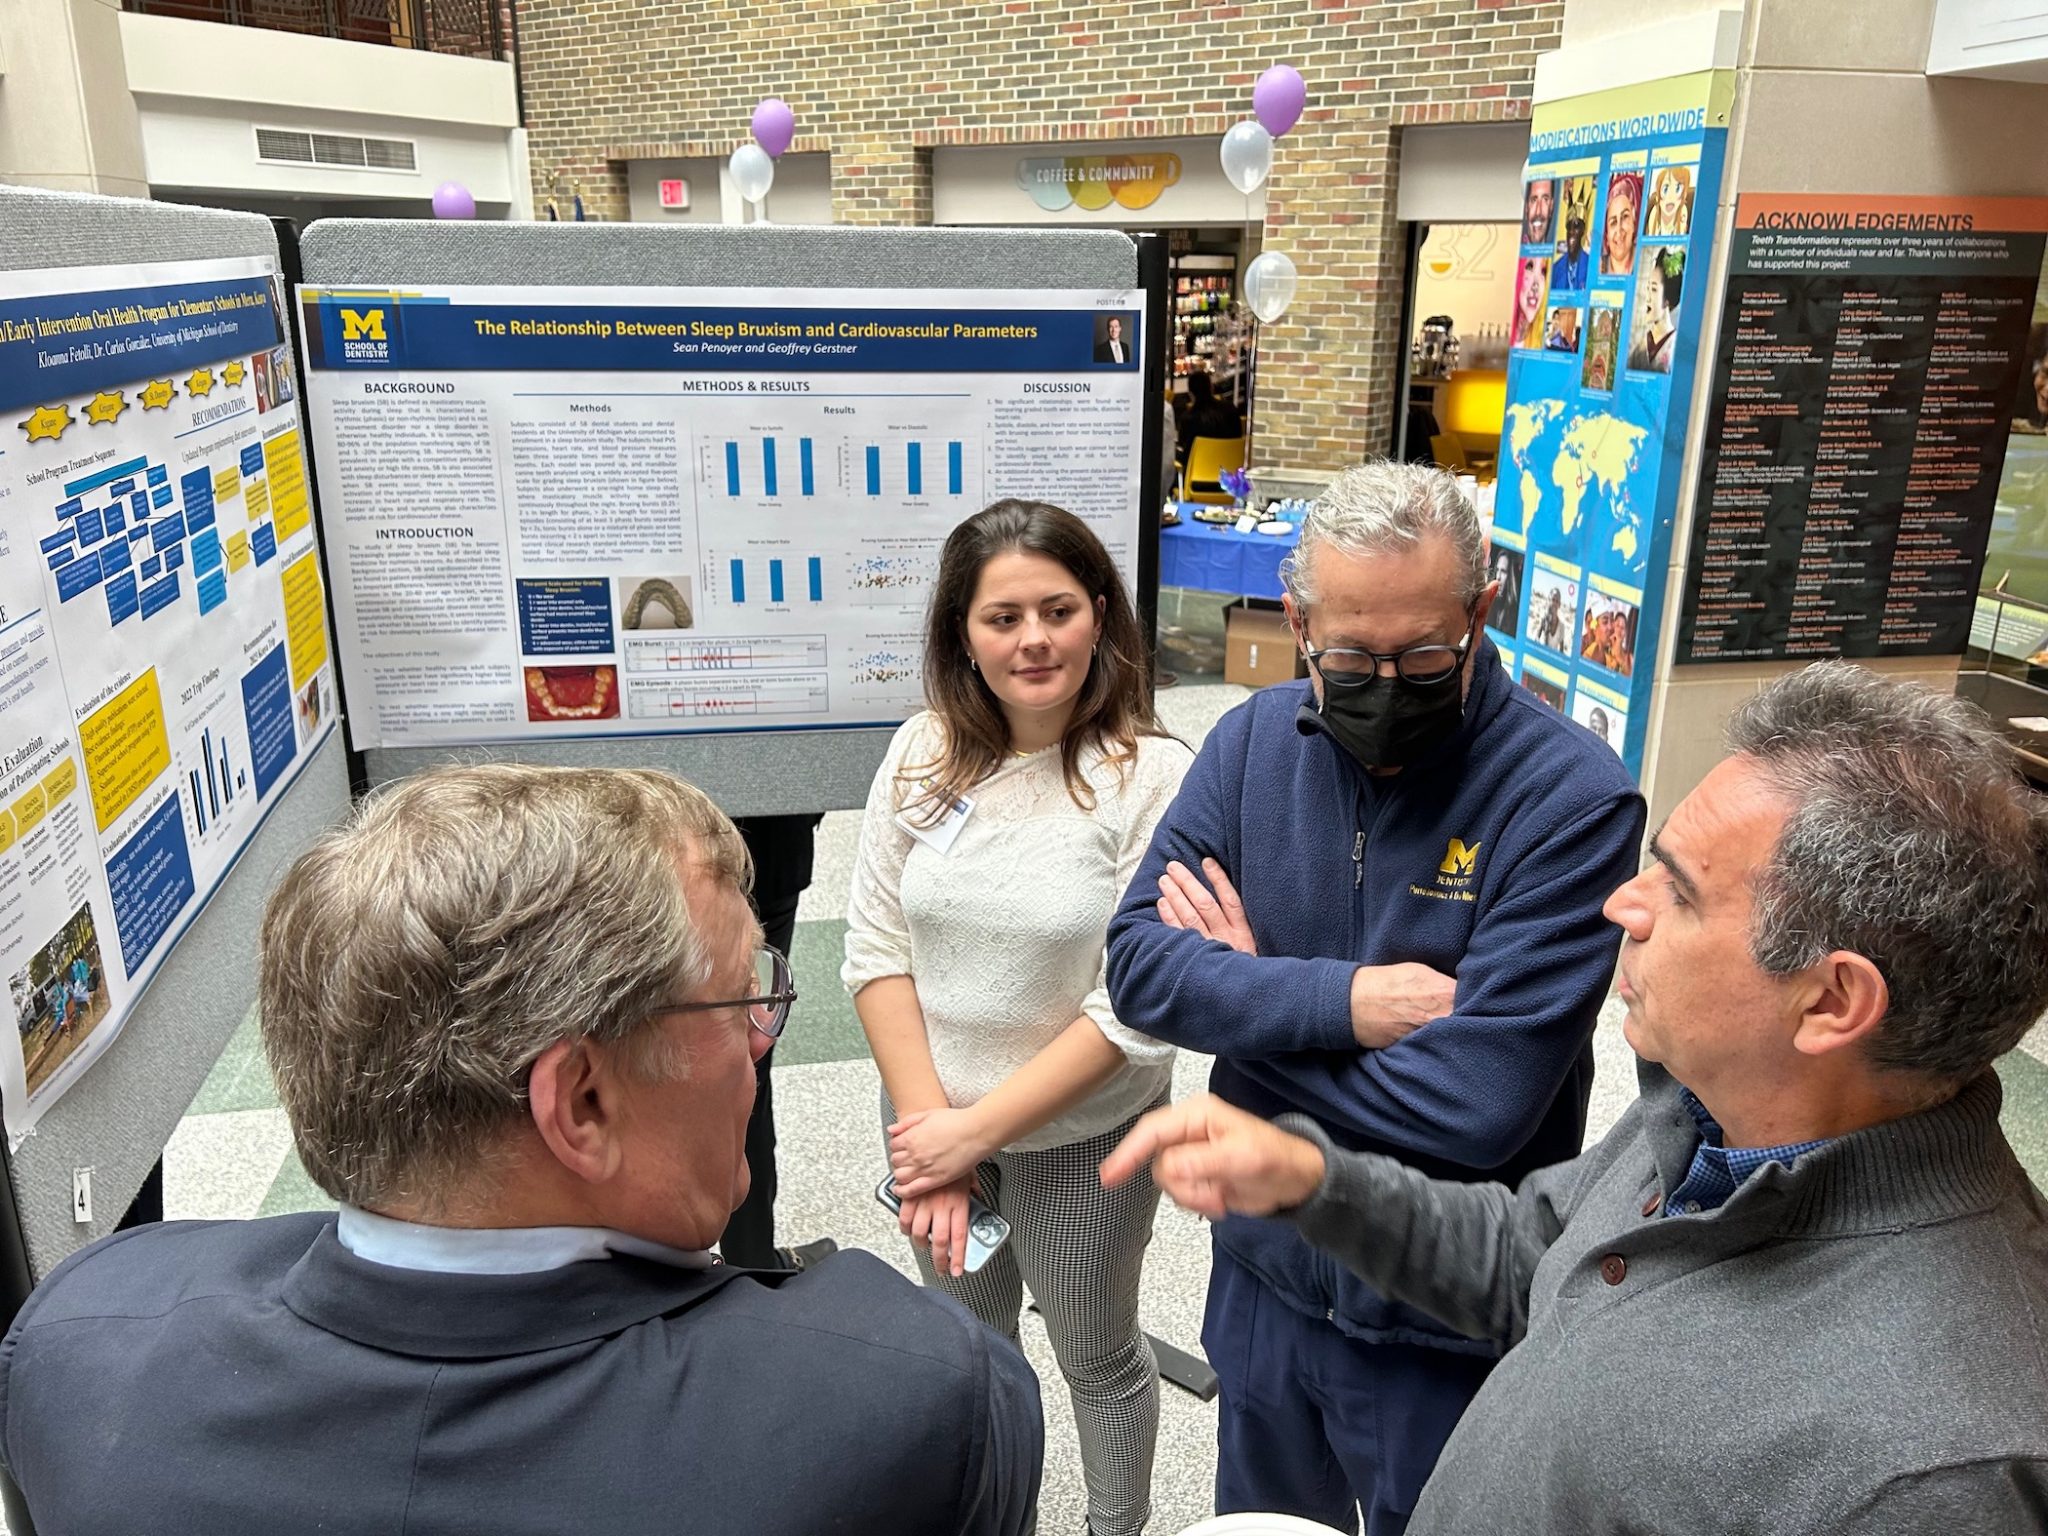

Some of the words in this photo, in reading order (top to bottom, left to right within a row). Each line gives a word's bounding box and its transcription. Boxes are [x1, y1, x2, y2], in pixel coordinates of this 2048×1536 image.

[1530, 122, 1616, 153] MODIFICATIONS
[1619, 108, 1705, 139] WORLDWIDE
[1036, 168, 1074, 183] COFFEE
[1077, 167, 1085, 182] &
[1089, 165, 1155, 181] COMMUNITY
[1753, 212, 1974, 232] ACKNOWLEDGEMENTS
[1751, 235, 1774, 245] Teeth
[1776, 235, 1840, 245] Transformations
[1841, 237, 1881, 247] represents
[1902, 237, 1921, 246] three
[1922, 239, 1946, 249] years
[1947, 237, 1955, 246] of
[1954, 237, 2006, 247] collaborations
[1749, 247, 1766, 257] with
[1775, 248, 1805, 257] number
[1806, 247, 1816, 257] of
[1817, 248, 1857, 257] individuals
[1858, 249, 1876, 257] near
[1877, 248, 1893, 257] and
[1893, 248, 1905, 258] far.
[1908, 248, 1931, 258] Thank
[1932, 251, 1946, 260] you
[1948, 249, 1956, 258] to
[1957, 251, 1991, 261] everyone
[1993, 249, 2009, 259] who
[1747, 260, 1762, 269] has
[1764, 260, 1804, 270] supported
[1806, 260, 1820, 269] this
[1821, 260, 1851, 271] project:
[35, 311, 94, 337] Intervention
[92, 308, 114, 329] Oral
[111, 305, 141, 326] Health
[137, 304, 169, 326] Program
[168, 301, 181, 319] for
[178, 299, 217, 316] Elementary
[214, 293, 236, 311] Schools
[235, 296, 242, 309] in
[474, 320, 506, 335] The
[510, 320, 612, 338] Relationship
[615, 321, 687, 336] Between
[691, 321, 734, 339] Sleep
[738, 322, 801, 337] Bruxism
[805, 322, 834, 338] and
[838, 323, 950, 338] Cardiovascular
[953, 324, 1038, 338] Parameters
[93, 343, 106, 358] Dr.
[104, 339, 126, 356] Carlos
[150, 330, 177, 347] University
[176, 328, 183, 346] of
[344, 342, 376, 350] SCHOOL
[377, 342, 388, 350] OF
[673, 342, 699, 353] Sean
[700, 342, 743, 355] Penoyer
[745, 342, 765, 353] and
[767, 342, 811, 356] Geoffrey
[813, 343, 858, 354] Gerstner
[345, 350, 389, 358] DENTISTRY
[364, 382, 455, 394] BACKGROUND
[682, 380, 744, 392] METHODS
[747, 381, 757, 392] &
[760, 381, 810, 392] RESULTS
[1023, 382, 1091, 393] DISCUSSION
[191, 396, 247, 427] RECOMMENDATIONS
[569, 404, 612, 412] Methods
[823, 406, 856, 414] Results
[26, 470, 45, 486] School
[45, 463, 69, 480] Program
[68, 455, 95, 471] Treatment
[94, 449, 116, 463] Sequence
[375, 527, 474, 540] INTRODUCTION
[192, 682, 203, 696] Trip
[202, 667, 220, 687] Findings
[75, 695, 101, 720] Evaluation
[4, 736, 44, 773] Evaluation
[8, 777, 16, 792] of
[15, 753, 51, 787] Participating
[50, 736, 70, 758] Schools
[102, 833, 127, 858] Evaluation
[78, 1189, 85, 1211] 4
